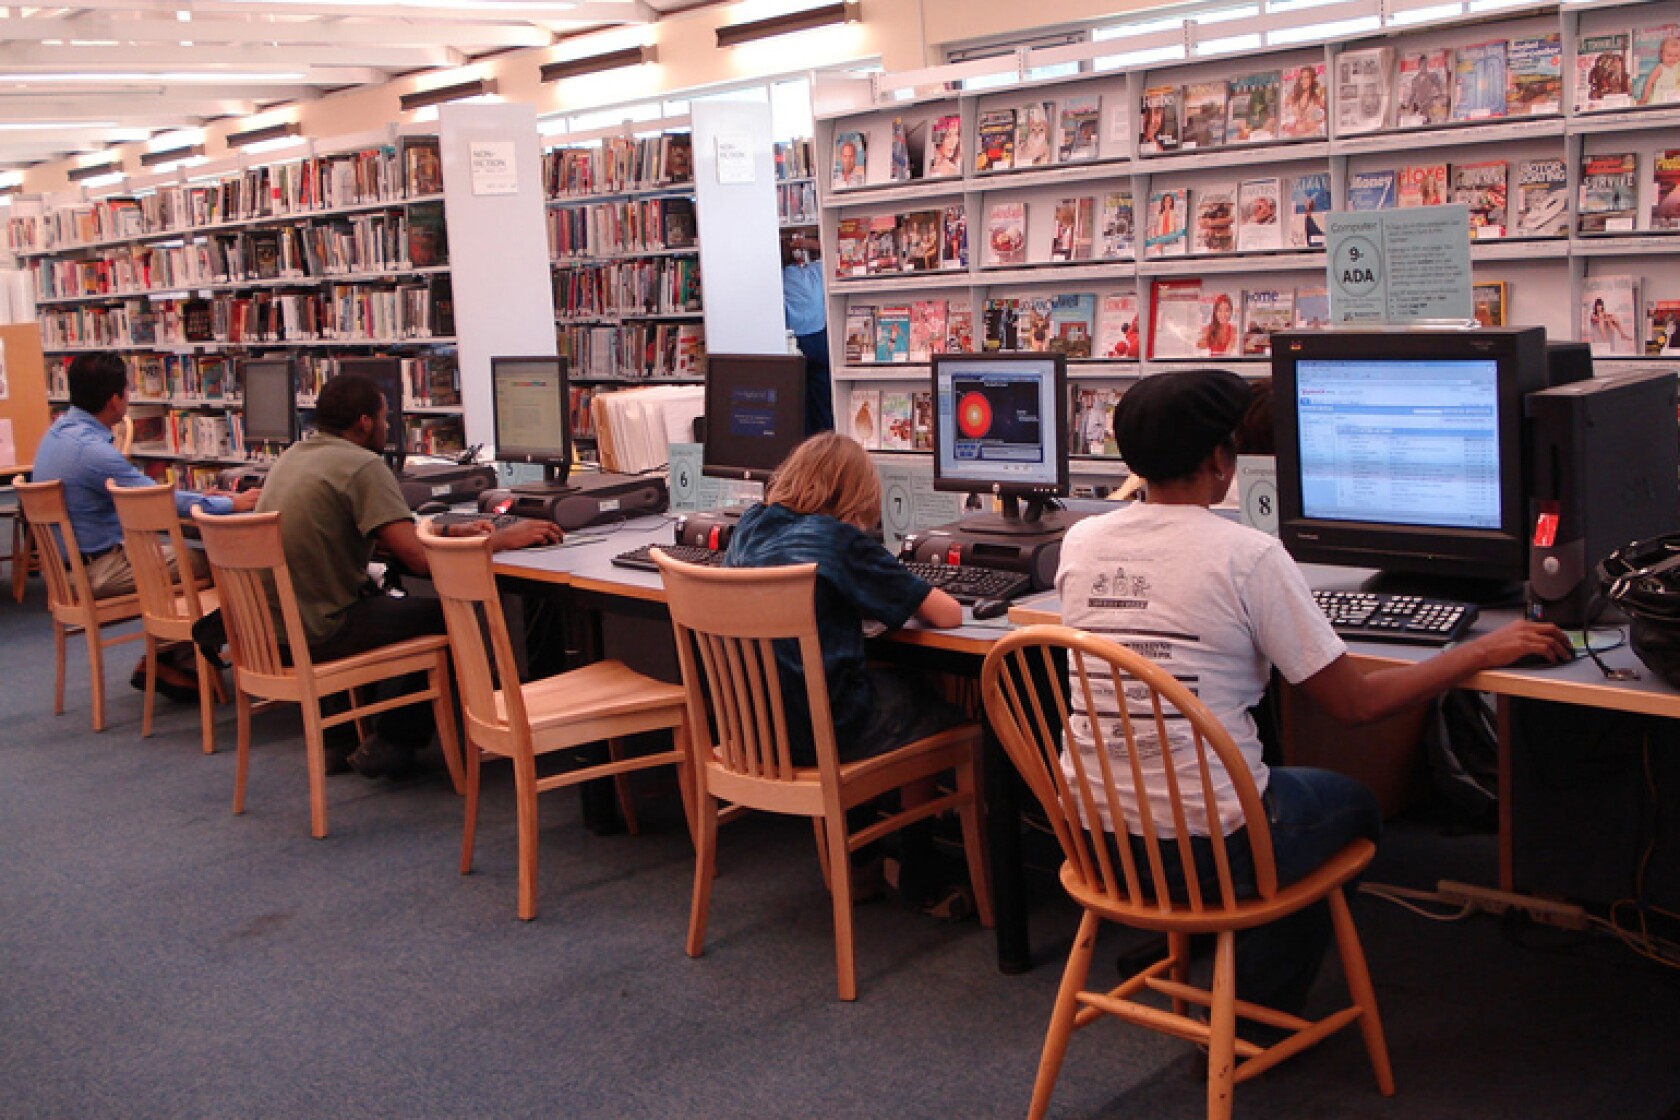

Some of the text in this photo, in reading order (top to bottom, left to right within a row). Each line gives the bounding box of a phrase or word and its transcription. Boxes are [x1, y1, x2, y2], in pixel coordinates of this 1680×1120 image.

[1331, 221, 1378, 234] Computer
[1343, 268, 1375, 284] ADA
[679, 471, 688, 487] 6
[894, 497, 902, 514] 7
[1258, 495, 1272, 516] 8
